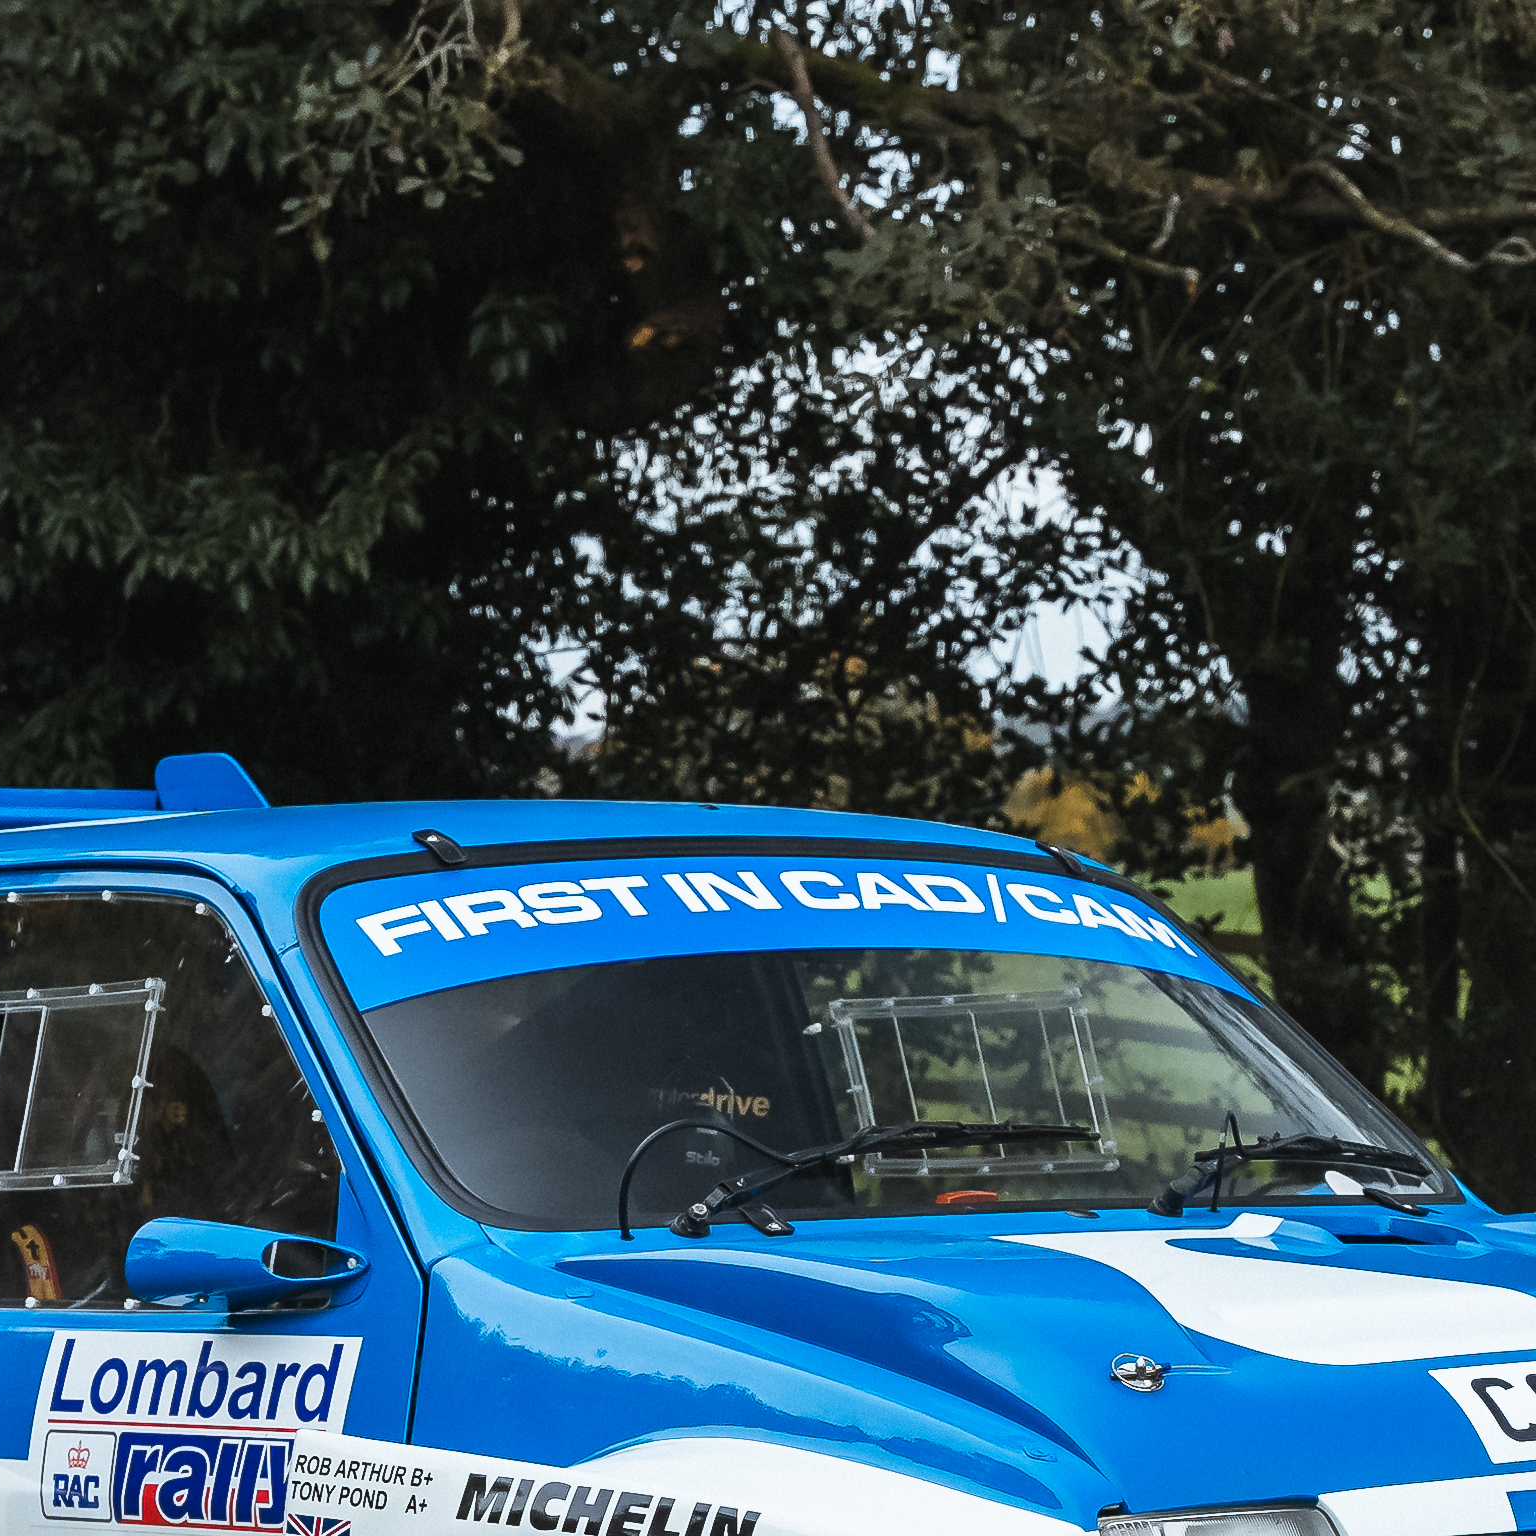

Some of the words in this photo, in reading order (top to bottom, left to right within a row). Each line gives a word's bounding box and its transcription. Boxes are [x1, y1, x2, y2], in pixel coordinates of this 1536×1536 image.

[355, 875, 649, 957] FIRST
[661, 871, 783, 914] IN
[779, 870, 1199, 958] CAD/CAM
[49, 1338, 345, 1423] Lombard
[52, 1473, 101, 1510] RAC
[121, 1437, 290, 1528] rally
[291, 1480, 337, 1504] TONY
[338, 1486, 388, 1510] POND
[404, 1494, 428, 1514] A+
[294, 1454, 332, 1476] ROB
[333, 1459, 407, 1486] ARTHUR
[410, 1467, 434, 1487] B+
